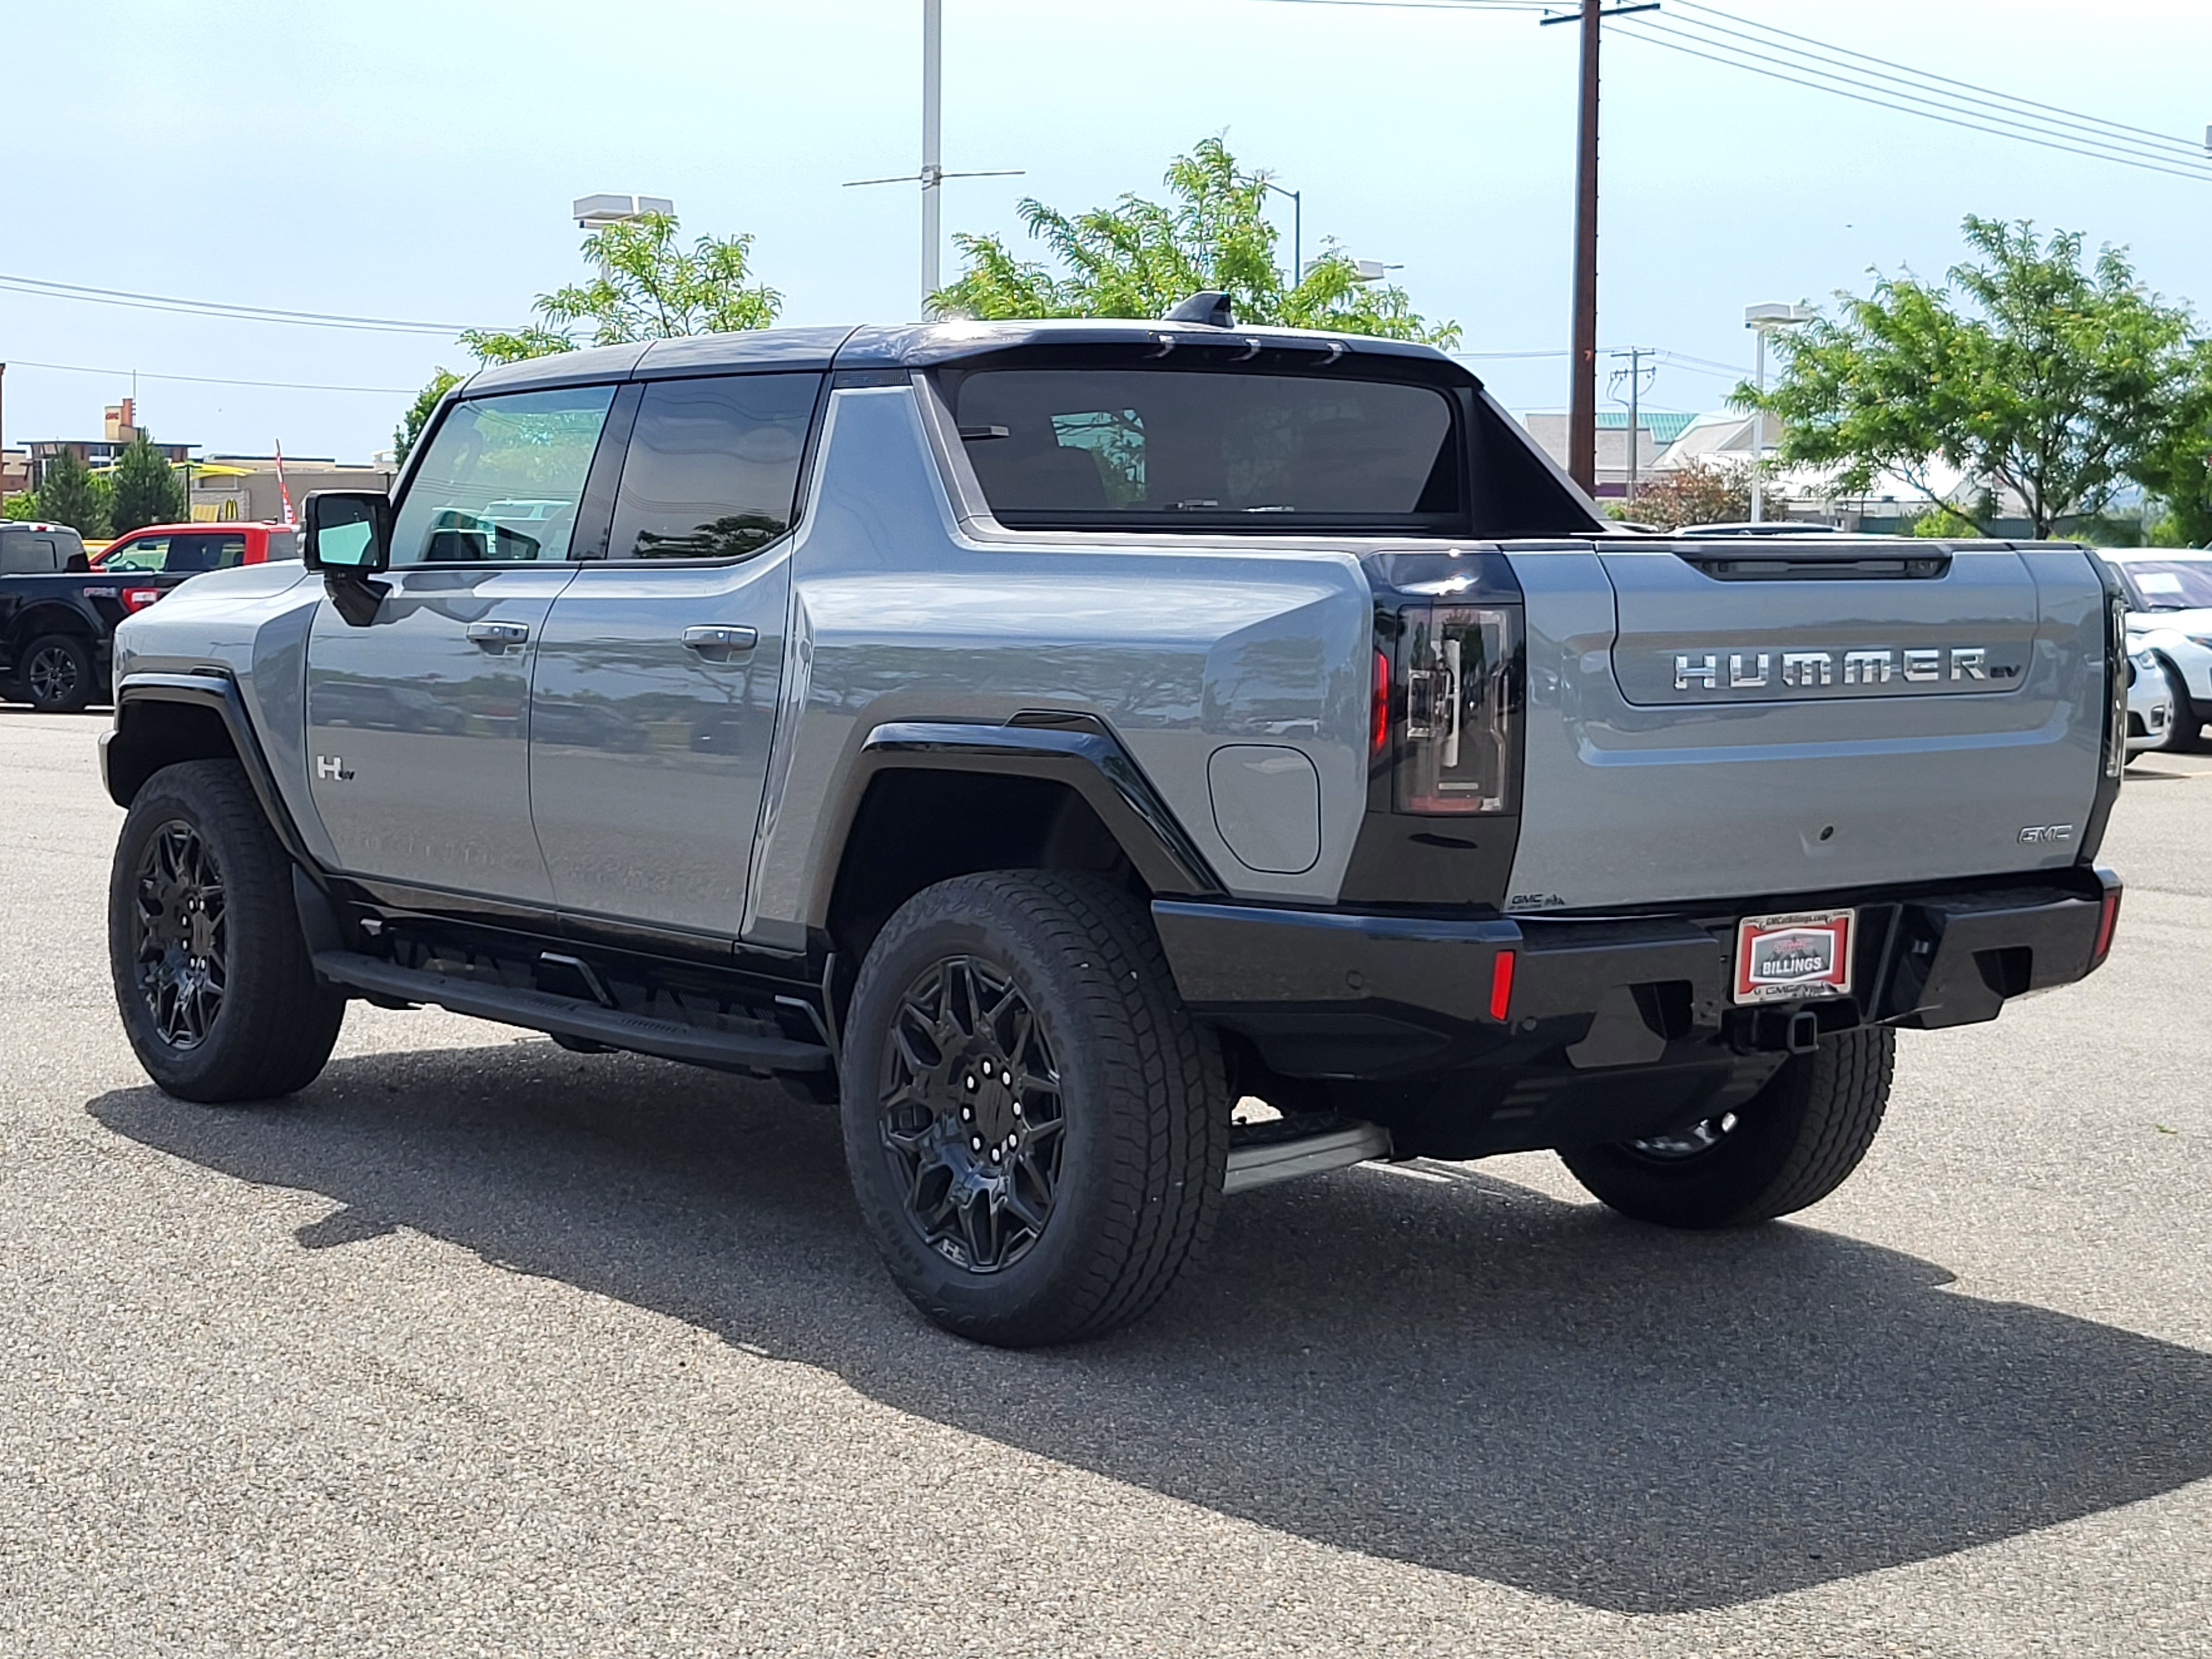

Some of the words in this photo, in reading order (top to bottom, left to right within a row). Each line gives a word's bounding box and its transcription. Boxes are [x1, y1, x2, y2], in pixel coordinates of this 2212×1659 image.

[1674, 648, 1986, 689] HUMMER
[1990, 665, 2021, 678] EV
[2017, 824, 2073, 843] GMC
[1512, 894, 1543, 904] GMC
[1762, 957, 1822, 975] BILLINGS
